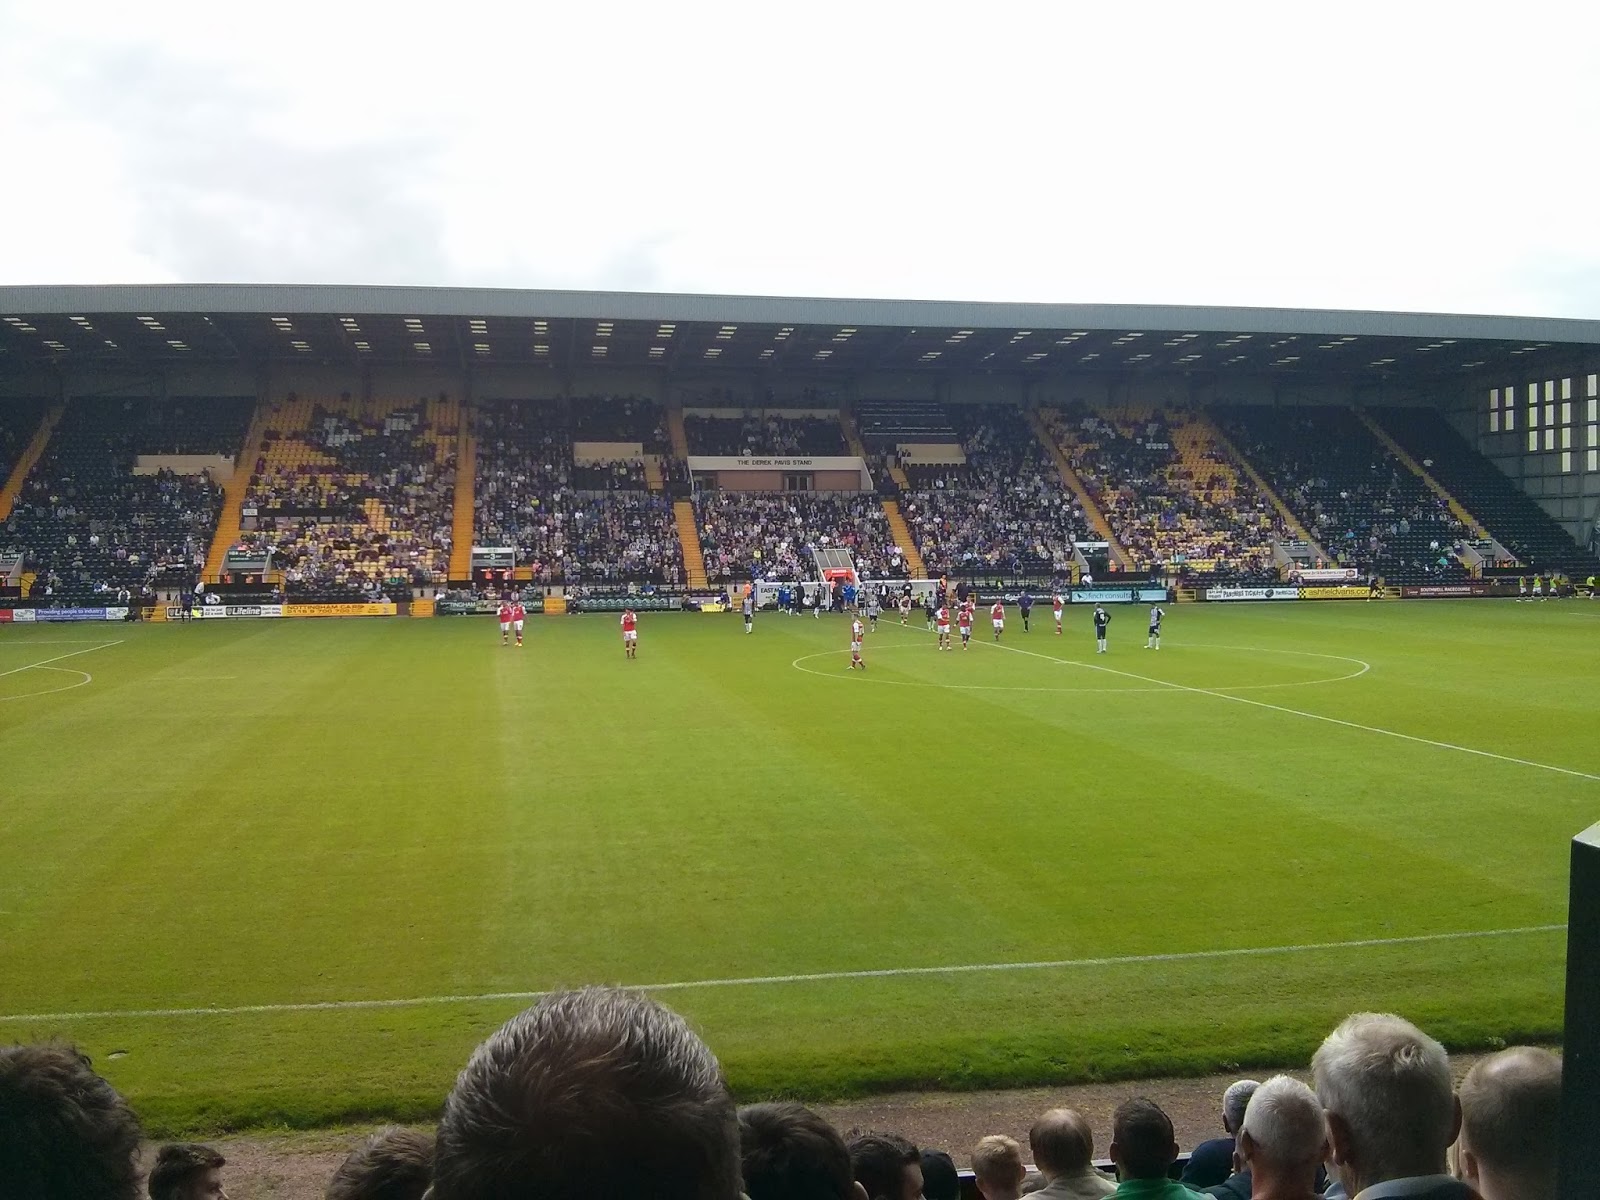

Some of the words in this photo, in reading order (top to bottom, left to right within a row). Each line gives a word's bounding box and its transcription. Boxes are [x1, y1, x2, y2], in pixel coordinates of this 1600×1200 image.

[38, 608, 60, 616] Providing
[61, 608, 78, 616] people
[84, 607, 104, 616] industry
[232, 606, 261, 615] Lifeline
